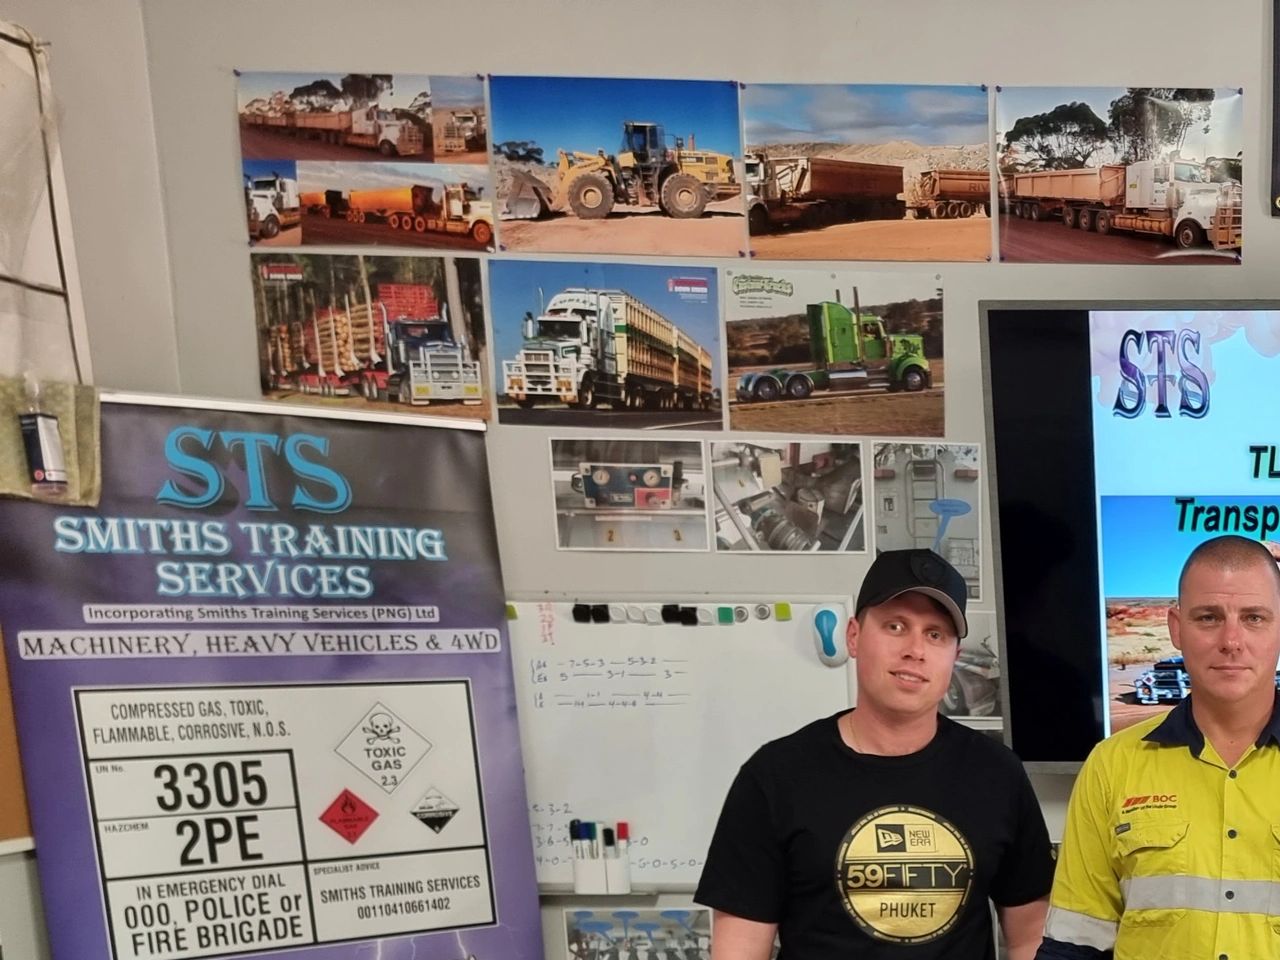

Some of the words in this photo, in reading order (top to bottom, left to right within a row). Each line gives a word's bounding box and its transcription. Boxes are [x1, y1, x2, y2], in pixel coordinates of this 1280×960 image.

[1112, 329, 1211, 419] STS
[156, 426, 351, 513] STS
[54, 516, 231, 554] SMITHS
[239, 523, 447, 559] TRAINING
[156, 560, 373, 598] SERVICES
[89, 606, 193, 622] Incorporating
[197, 606, 247, 619] Smiths
[251, 606, 308, 622] Training
[313, 606, 368, 619] Services
[372, 606, 411, 621] (PNG)
[416, 606, 435, 619] Ltd
[23, 634, 198, 657] MACHINERY,
[207, 632, 296, 654] HEAVY
[304, 633, 418, 653] VEHICLES
[426, 636, 441, 650] &
[452, 632, 498, 651] 4WD
[111, 702, 195, 720] COMPRESSED
[198, 702, 227, 718] GAS,
[230, 700, 269, 717] TOXIC,
[93, 724, 175, 744] FLAMMABLE,
[178, 722, 250, 741] CORROSIVE,
[253, 721, 290, 738] N.O.S.
[364, 746, 406, 758] TOXIC
[371, 758, 402, 771] GAS
[153, 760, 268, 812] 3305
[104, 822, 148, 833] HAZCHEM
[176, 815, 263, 866] 2PE
[137, 886, 154, 901] IN
[159, 878, 245, 899] EMERGENCY
[252, 873, 286, 889] DIAL
[847, 864, 963, 888] 59FIFTY
[186, 895, 270, 924] POLICE
[280, 894, 302, 912] or
[357, 898, 450, 919] 00110410661402
[880, 903, 936, 918] PHUKET
[132, 929, 188, 956] FIRE
[198, 916, 303, 949] BRIGADE
